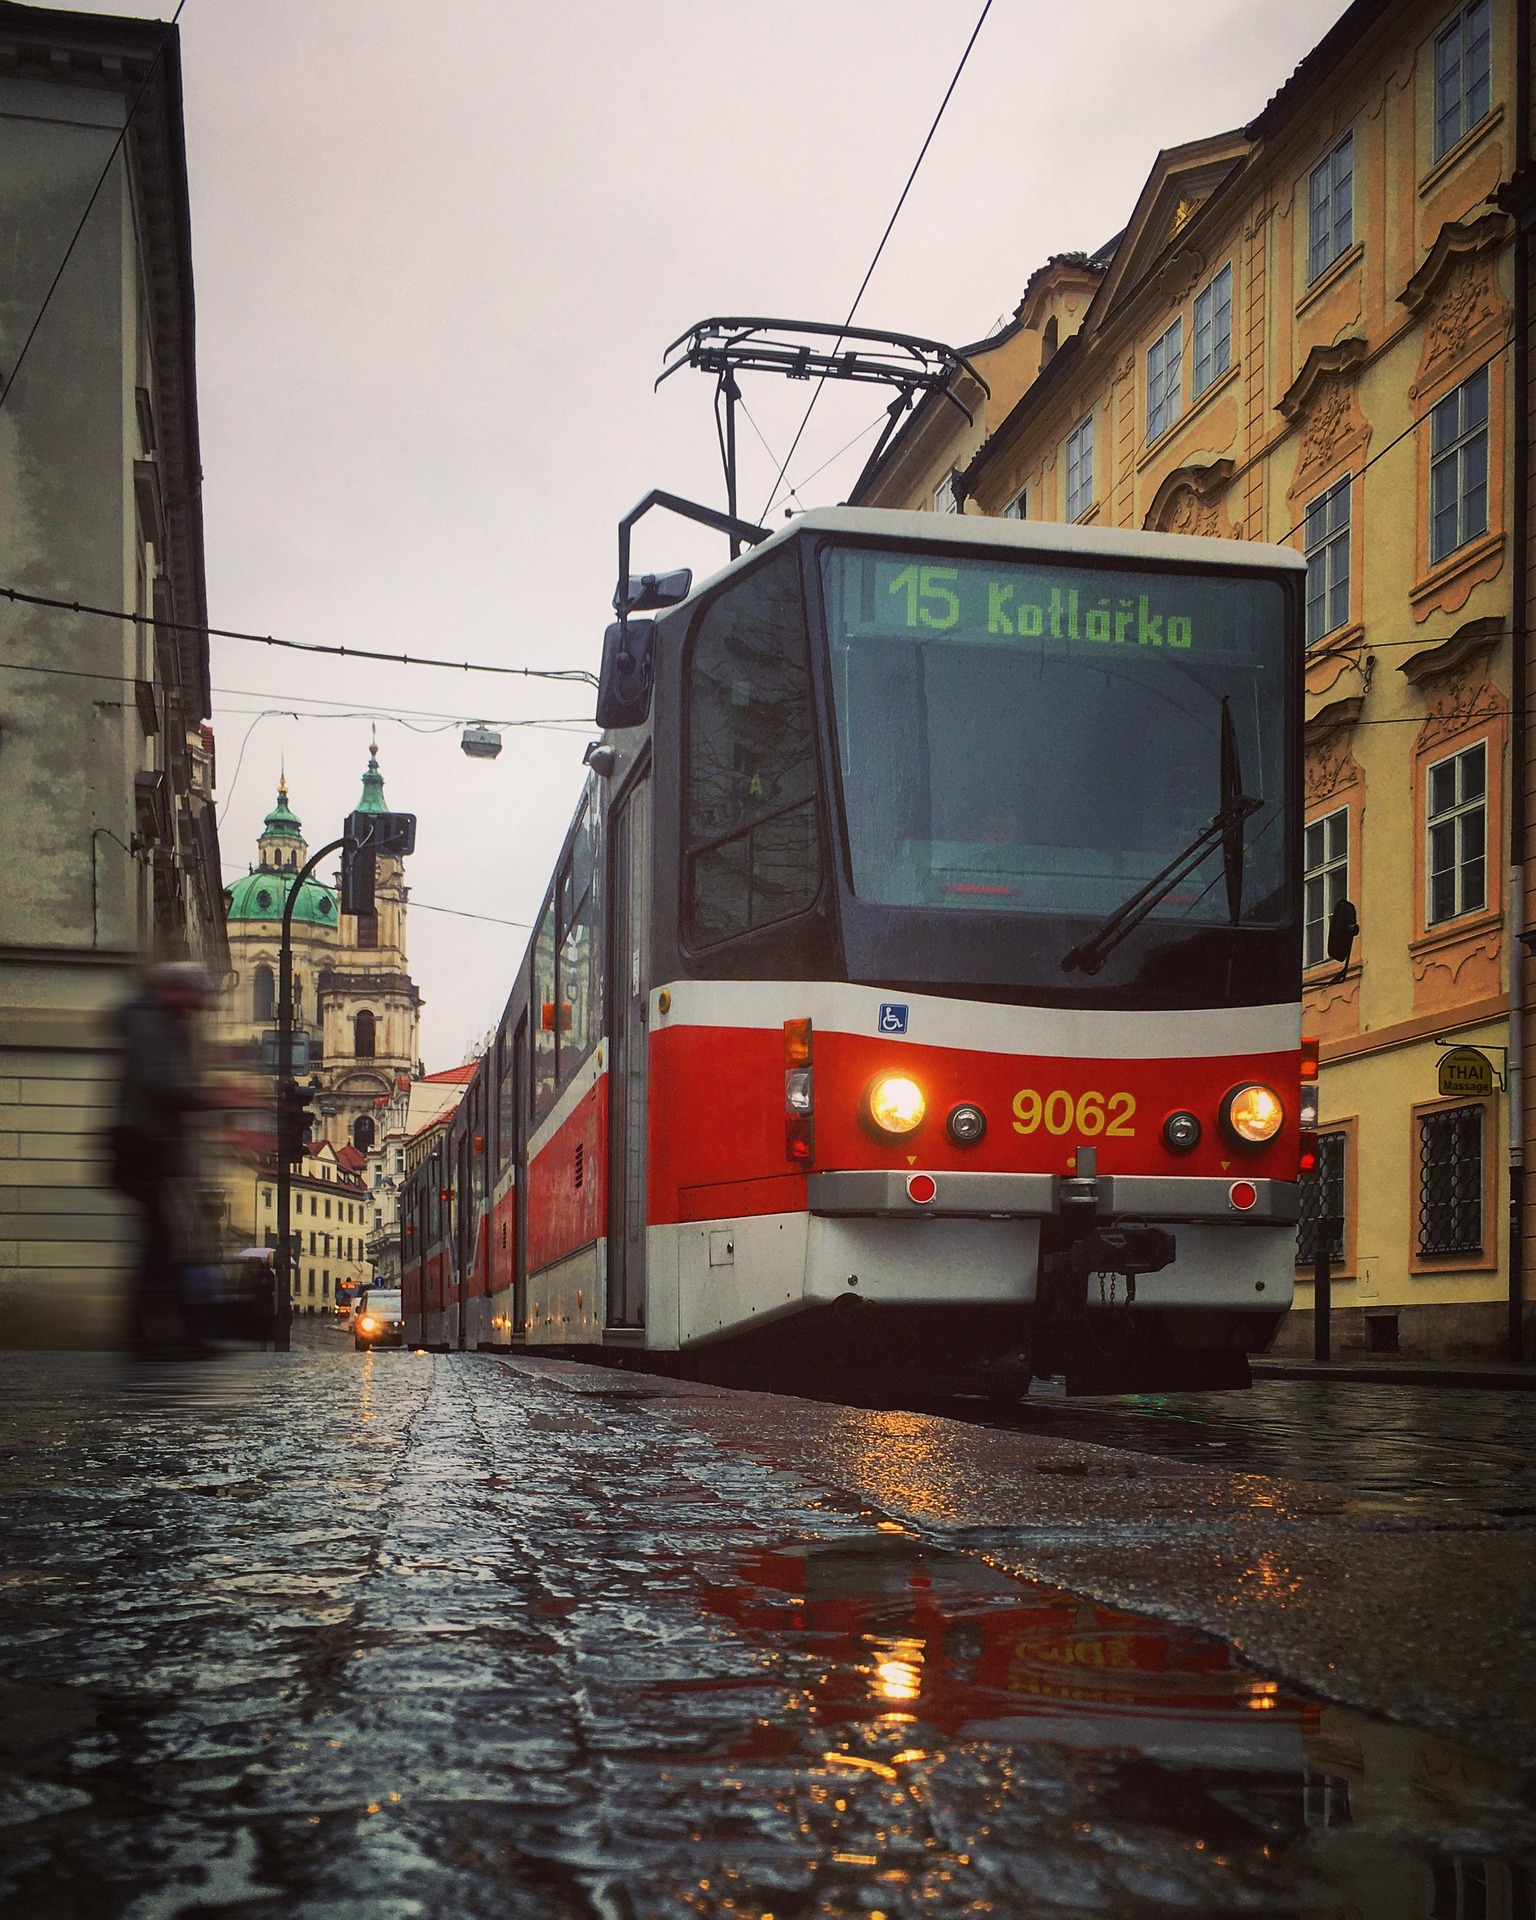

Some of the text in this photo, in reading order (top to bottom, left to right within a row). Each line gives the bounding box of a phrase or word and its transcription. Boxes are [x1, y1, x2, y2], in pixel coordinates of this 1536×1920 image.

[889, 564, 1192, 648] 15 Kotlářka
[1444, 1080, 1489, 1094] Massage
[1447, 1065, 1483, 1080] THAI
[1012, 1089, 1136, 1137] 9062
